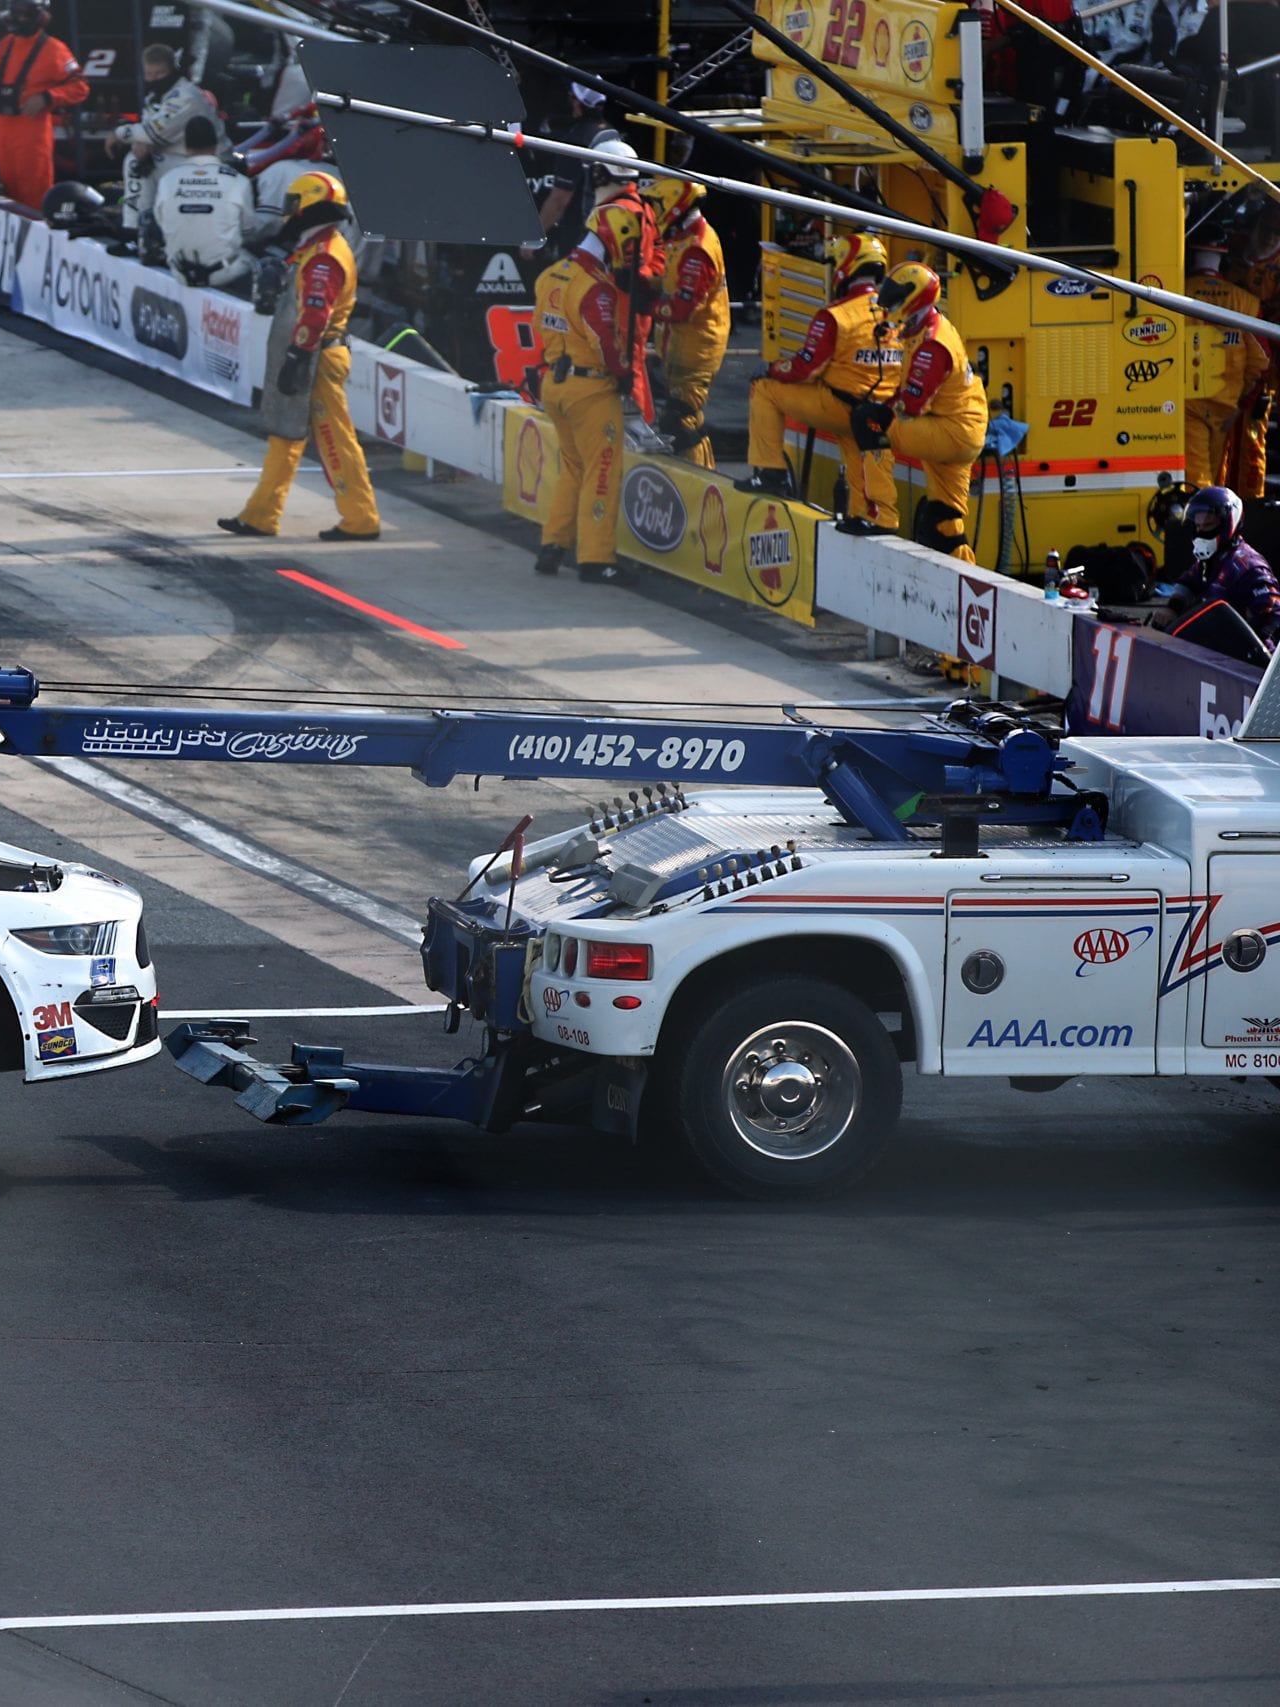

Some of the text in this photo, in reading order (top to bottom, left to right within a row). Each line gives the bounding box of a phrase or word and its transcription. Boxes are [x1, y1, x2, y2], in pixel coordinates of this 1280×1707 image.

[41, 234, 120, 330] Acronis
[476, 282, 526, 293] AXALTA
[1054, 278, 1088, 295] Ford
[1129, 322, 1168, 338] PENNZOIL
[1048, 399, 1097, 427] 22
[633, 475, 675, 541] Ford
[749, 530, 792, 568] PENNZOIL
[1086, 623, 1137, 733] 11
[508, 734, 572, 763] (410)
[1080, 929, 1125, 962] AAA
[32, 1001, 74, 1031] 3M
[41, 1039, 75, 1051] SUNOCO
[557, 1025, 590, 1046] 08-108
[967, 1019, 1133, 1047] AAA.com
[1225, 1053, 1280, 1068] MC 810
